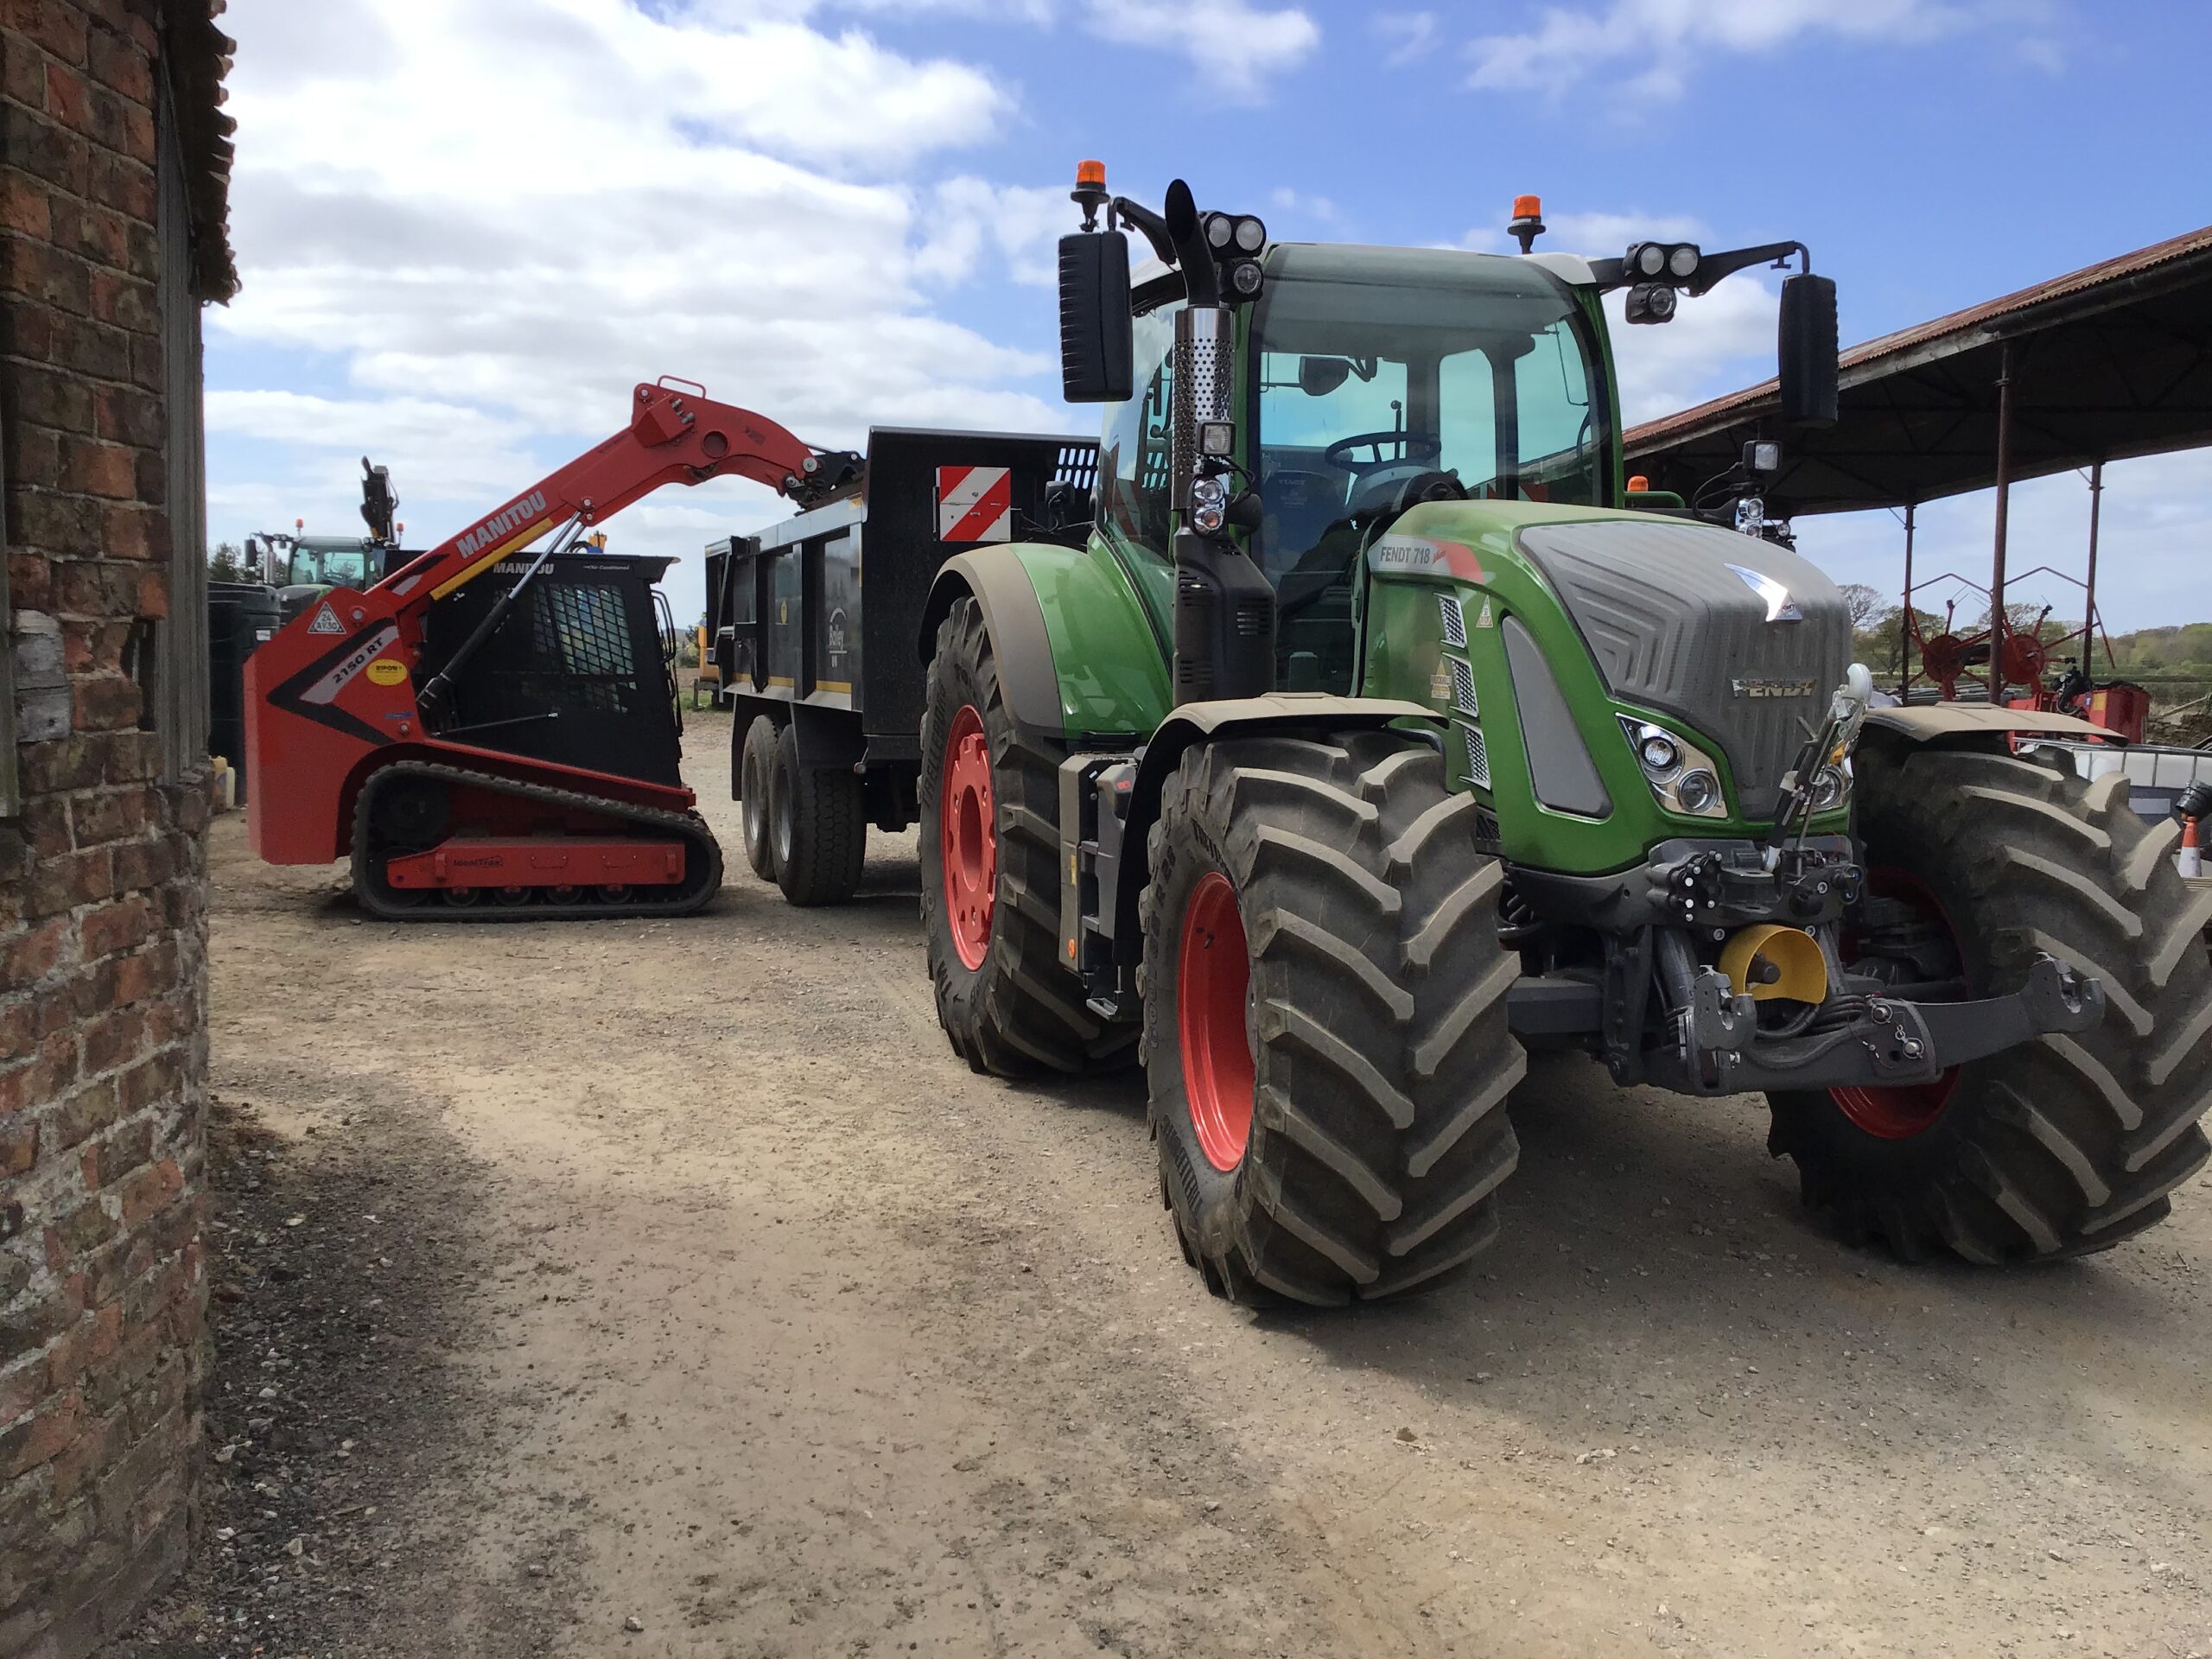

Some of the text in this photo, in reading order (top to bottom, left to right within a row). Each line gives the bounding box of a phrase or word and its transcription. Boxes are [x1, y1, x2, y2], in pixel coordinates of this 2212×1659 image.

[455, 490, 547, 559] MANITOU
[1380, 546, 1412, 563] FENDT
[1414, 548, 1431, 564] 718
[493, 563, 554, 575] MANIOU
[333, 654, 365, 684] 2150
[365, 637, 384, 655] RT
[1731, 678, 1817, 697] FENDT
